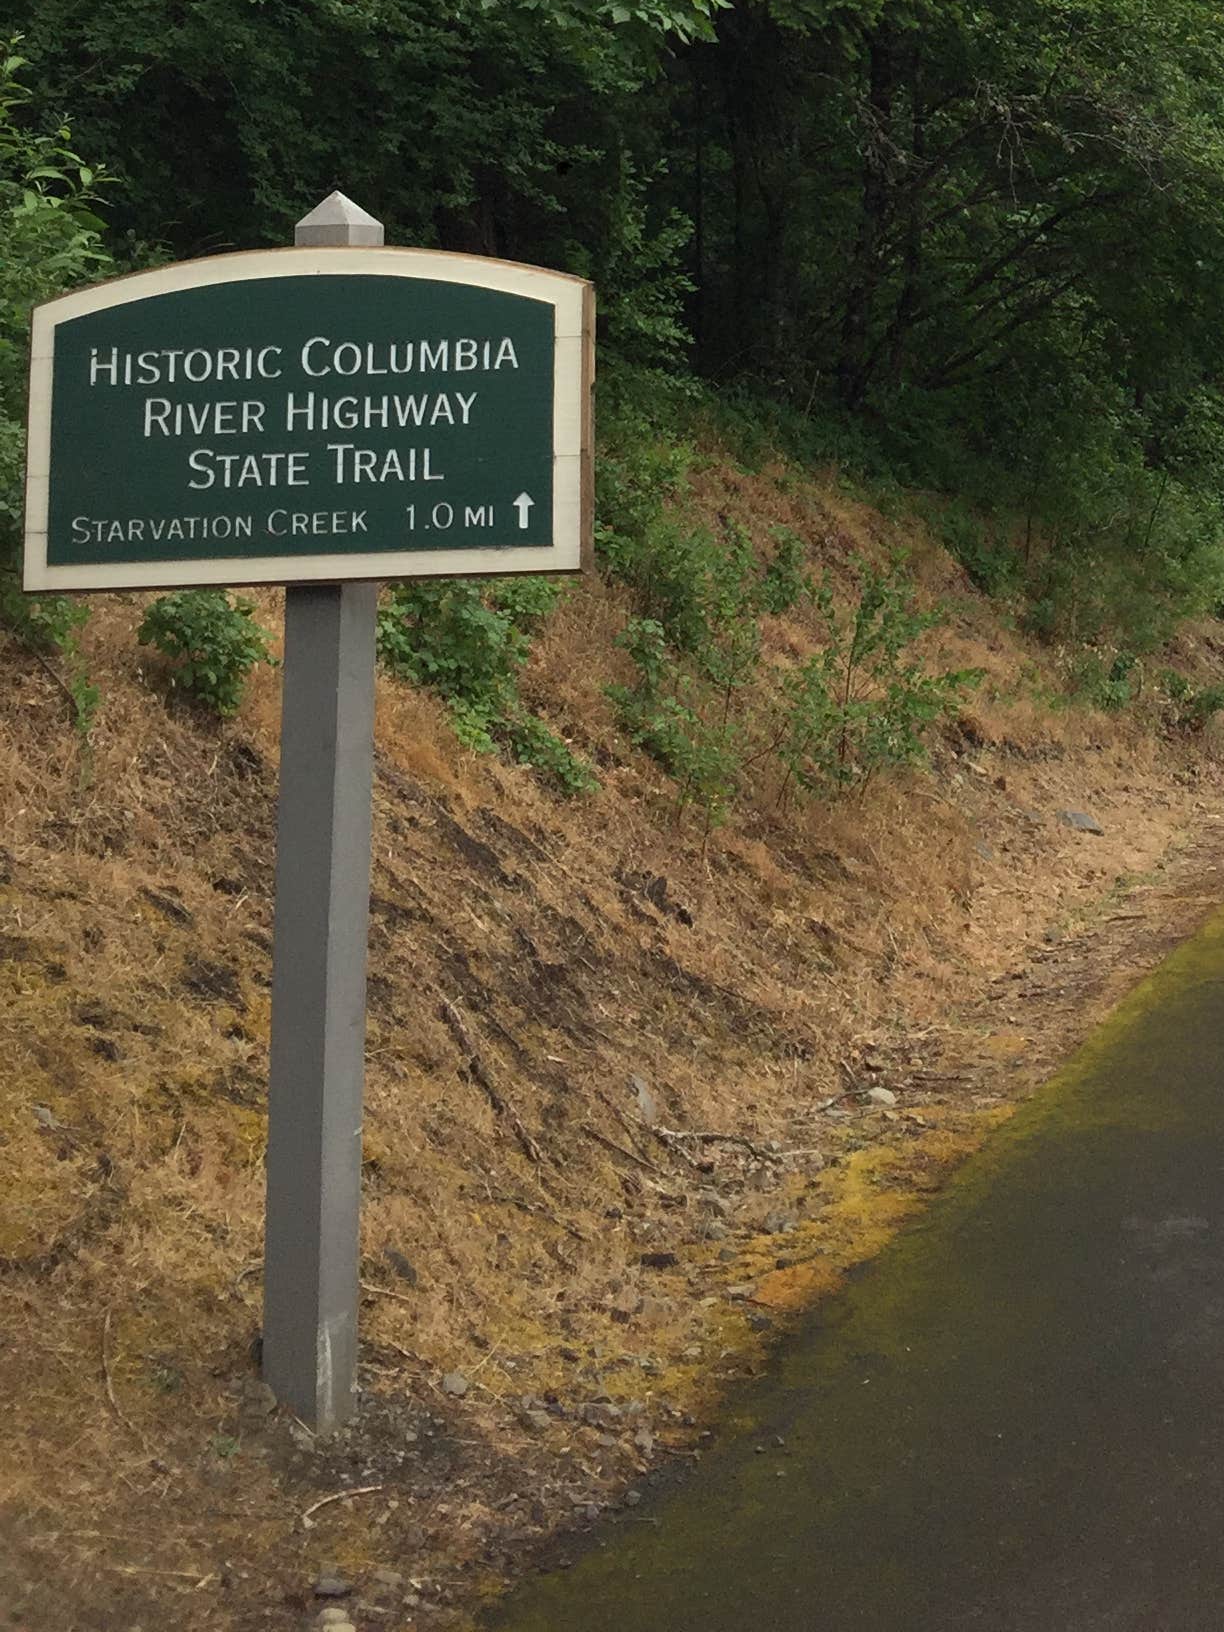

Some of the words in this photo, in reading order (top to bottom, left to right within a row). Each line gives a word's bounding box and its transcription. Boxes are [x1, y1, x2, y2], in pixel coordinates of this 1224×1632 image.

[90, 346, 282, 386] HISTORIC
[301, 336, 519, 378] COLUMBIA
[144, 398, 265, 437] RIVER
[286, 391, 478, 432] HIGHWAY
[187, 449, 310, 490] STATE
[327, 443, 445, 484] TRAIL
[71, 515, 252, 545] STARVATION
[267, 509, 369, 536] CREEK
[404, 502, 454, 531] 1.0
[464, 504, 494, 528] MI
